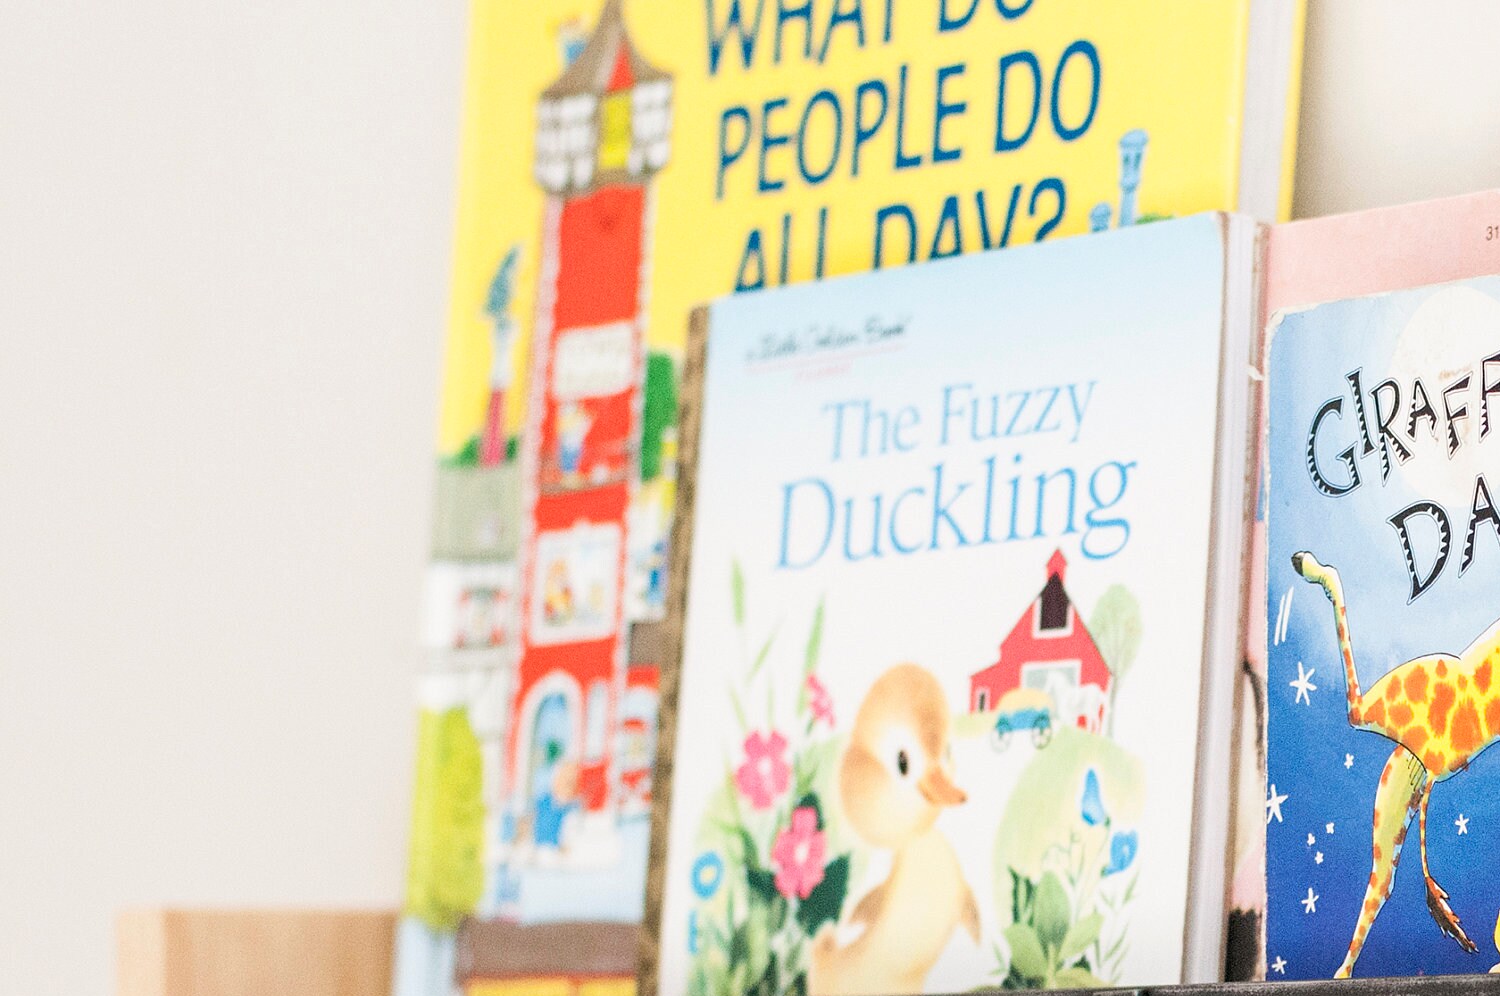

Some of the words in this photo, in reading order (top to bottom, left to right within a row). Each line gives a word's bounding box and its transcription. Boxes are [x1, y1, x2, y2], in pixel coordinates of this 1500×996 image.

[714, 63, 967, 201] PEOPLE
[993, 39, 1102, 153] DO
[820, 398, 924, 463] The
[938, 379, 1099, 446] Fuzzy
[772, 452, 1139, 572] Duckling
